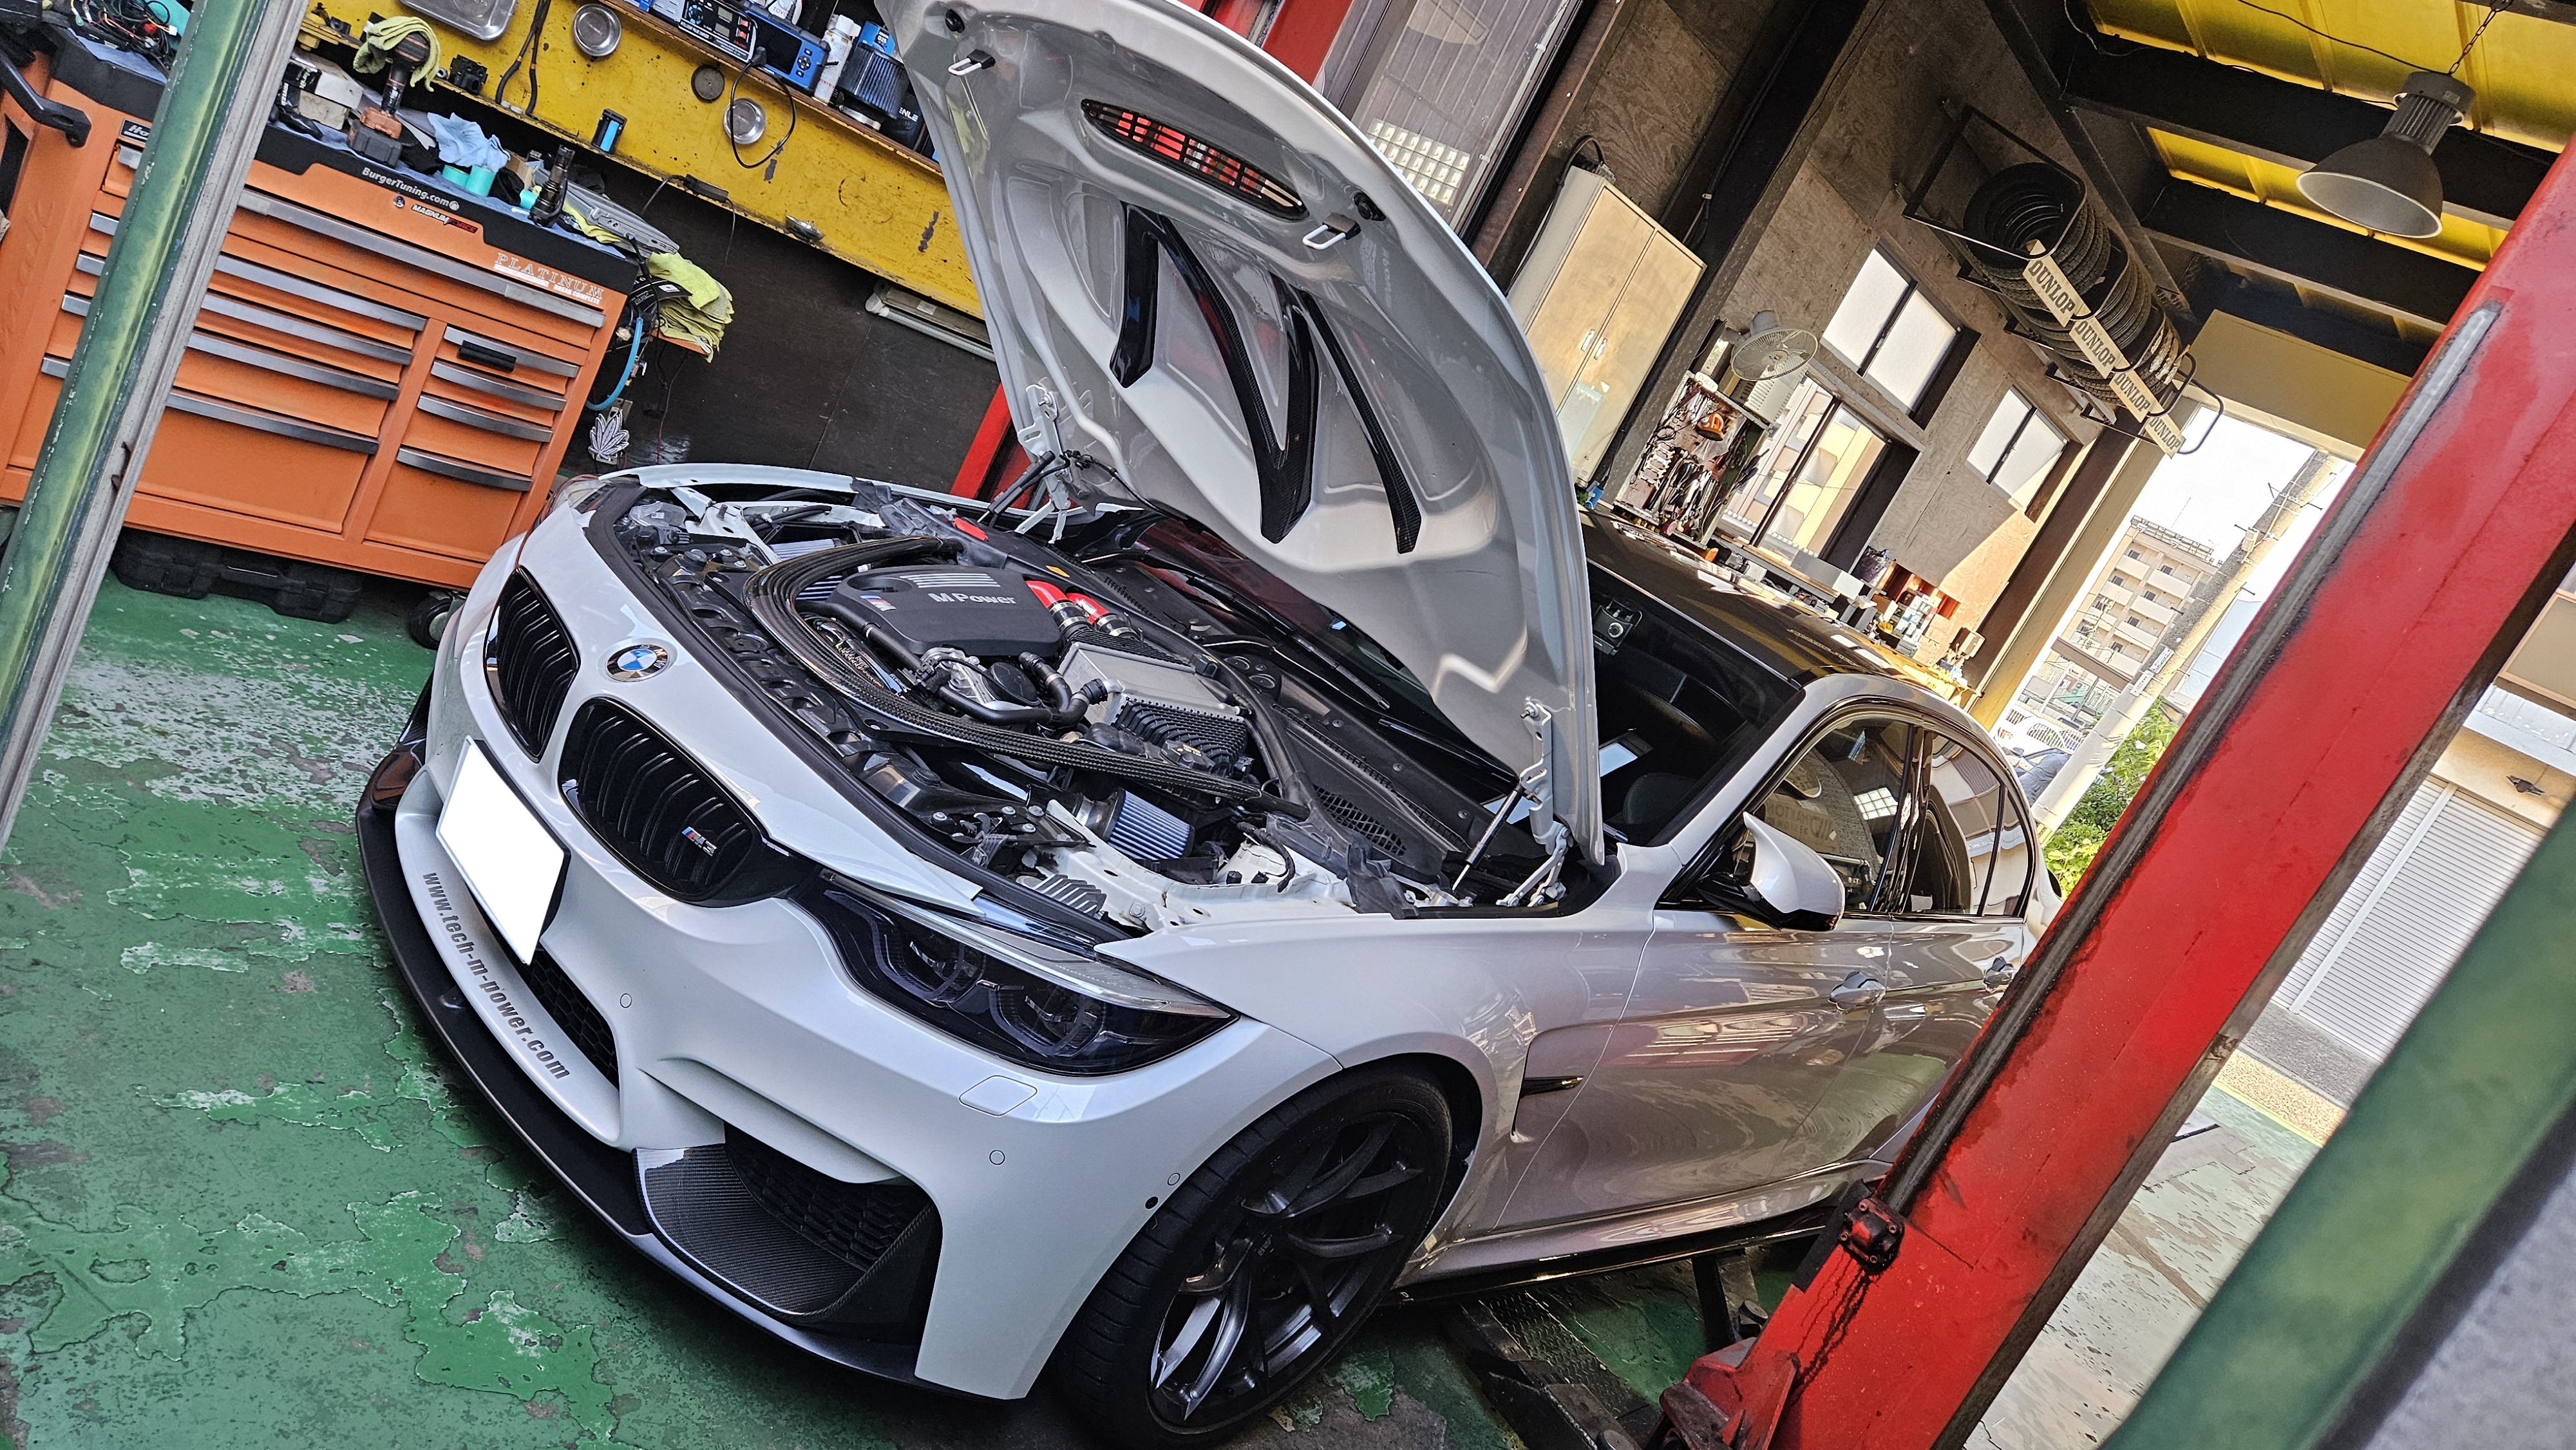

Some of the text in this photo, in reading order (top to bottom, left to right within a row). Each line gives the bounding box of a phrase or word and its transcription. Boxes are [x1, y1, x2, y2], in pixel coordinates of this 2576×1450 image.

[362, 166, 450, 207] BurgerTuning.com
[495, 252, 604, 300] PLATINUM
[572, 290, 600, 305] COMPLETE
[2029, 259, 2075, 315] DUNLOP
[2076, 320, 2116, 368] DUNLOP
[2115, 372, 2150, 412] DUNLOP
[2149, 416, 2183, 451] DUNLOP
[422, 872, 571, 1080] www.tech-m-power.com
